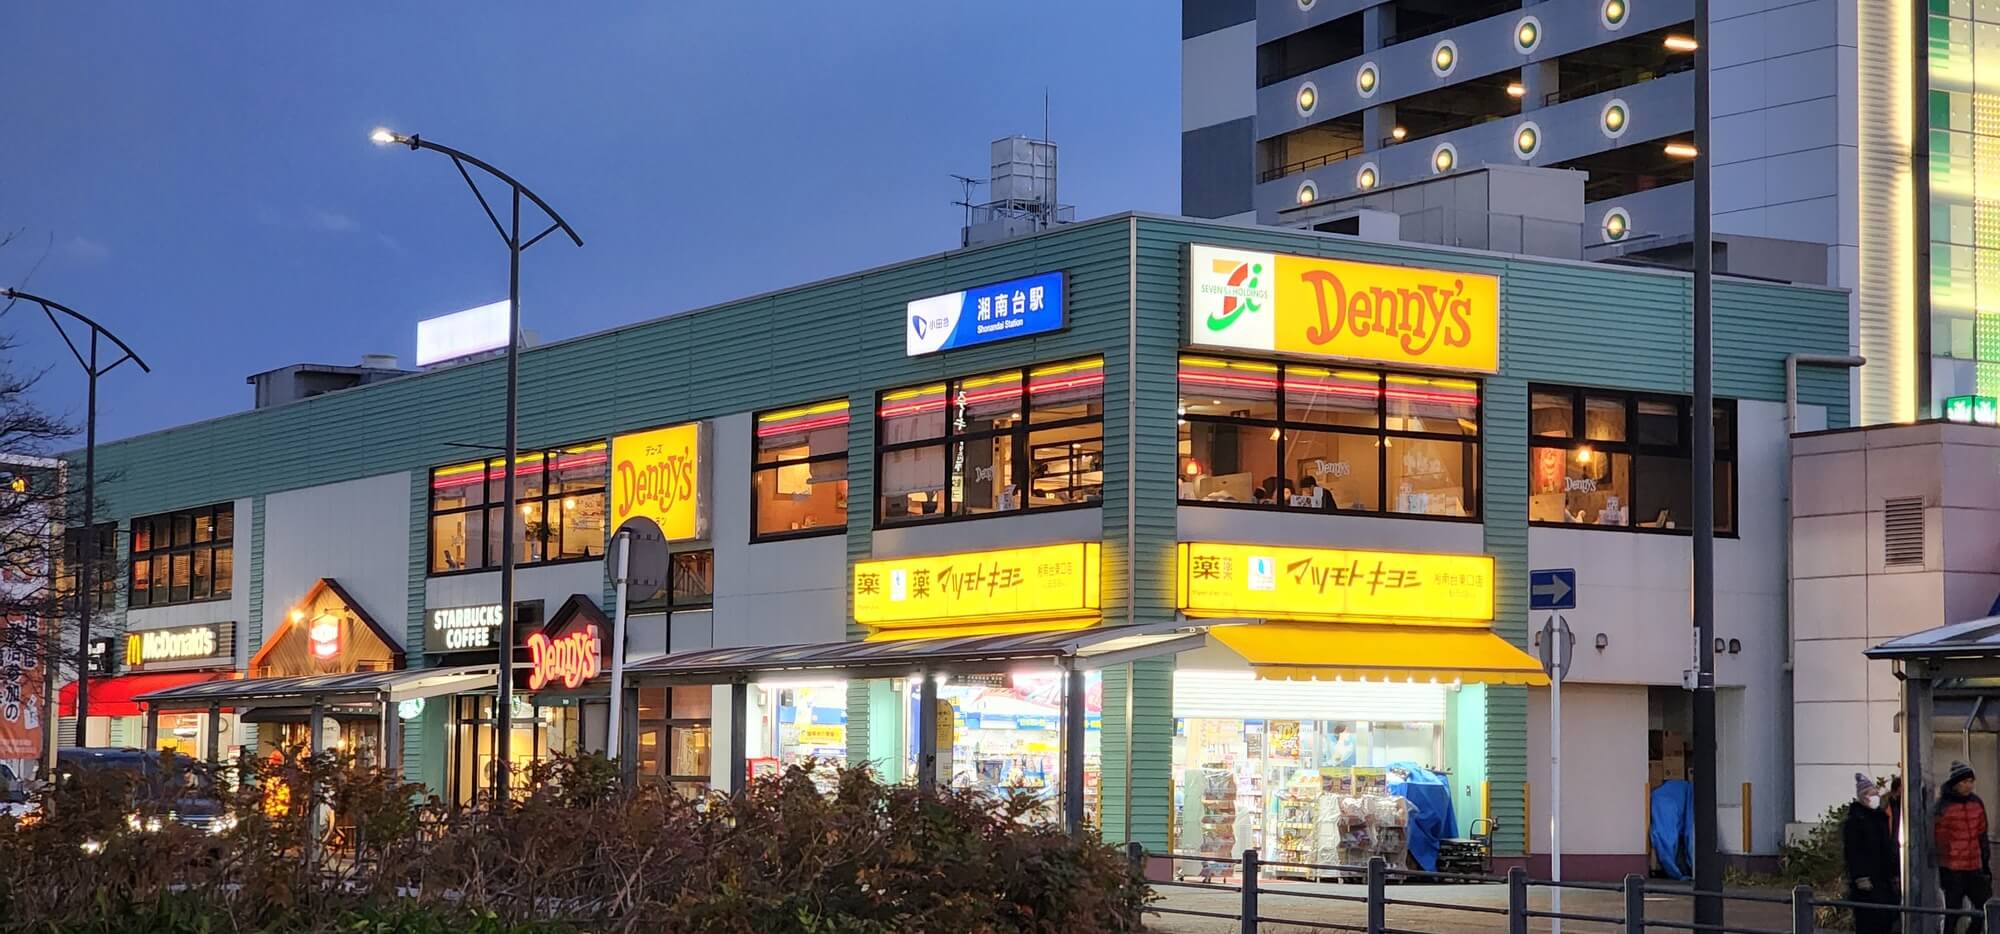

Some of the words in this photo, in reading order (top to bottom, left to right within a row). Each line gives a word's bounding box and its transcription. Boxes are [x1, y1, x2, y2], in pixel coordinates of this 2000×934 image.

[977, 285, 1045, 321] 湘南台駅
[1232, 286, 1268, 299] HOLDINGS
[929, 317, 950, 330] 小田急
[977, 321, 1004, 335] Shonandai
[1004, 318, 1024, 330] Station
[1301, 269, 1472, 356] Denny's
[617, 445, 693, 518] Denny's
[857, 573, 881, 595] 薬
[912, 568, 931, 599] 薬
[937, 560, 1024, 600] マツモトキヨシ
[1192, 555, 1221, 580] 薬
[1286, 556, 1423, 596] マツモトキヨシ
[434, 605, 504, 631] STARBUCKS
[142, 627, 215, 659] McDonald's
[446, 627, 490, 649] COFFEE
[527, 624, 600, 690] Denny's
